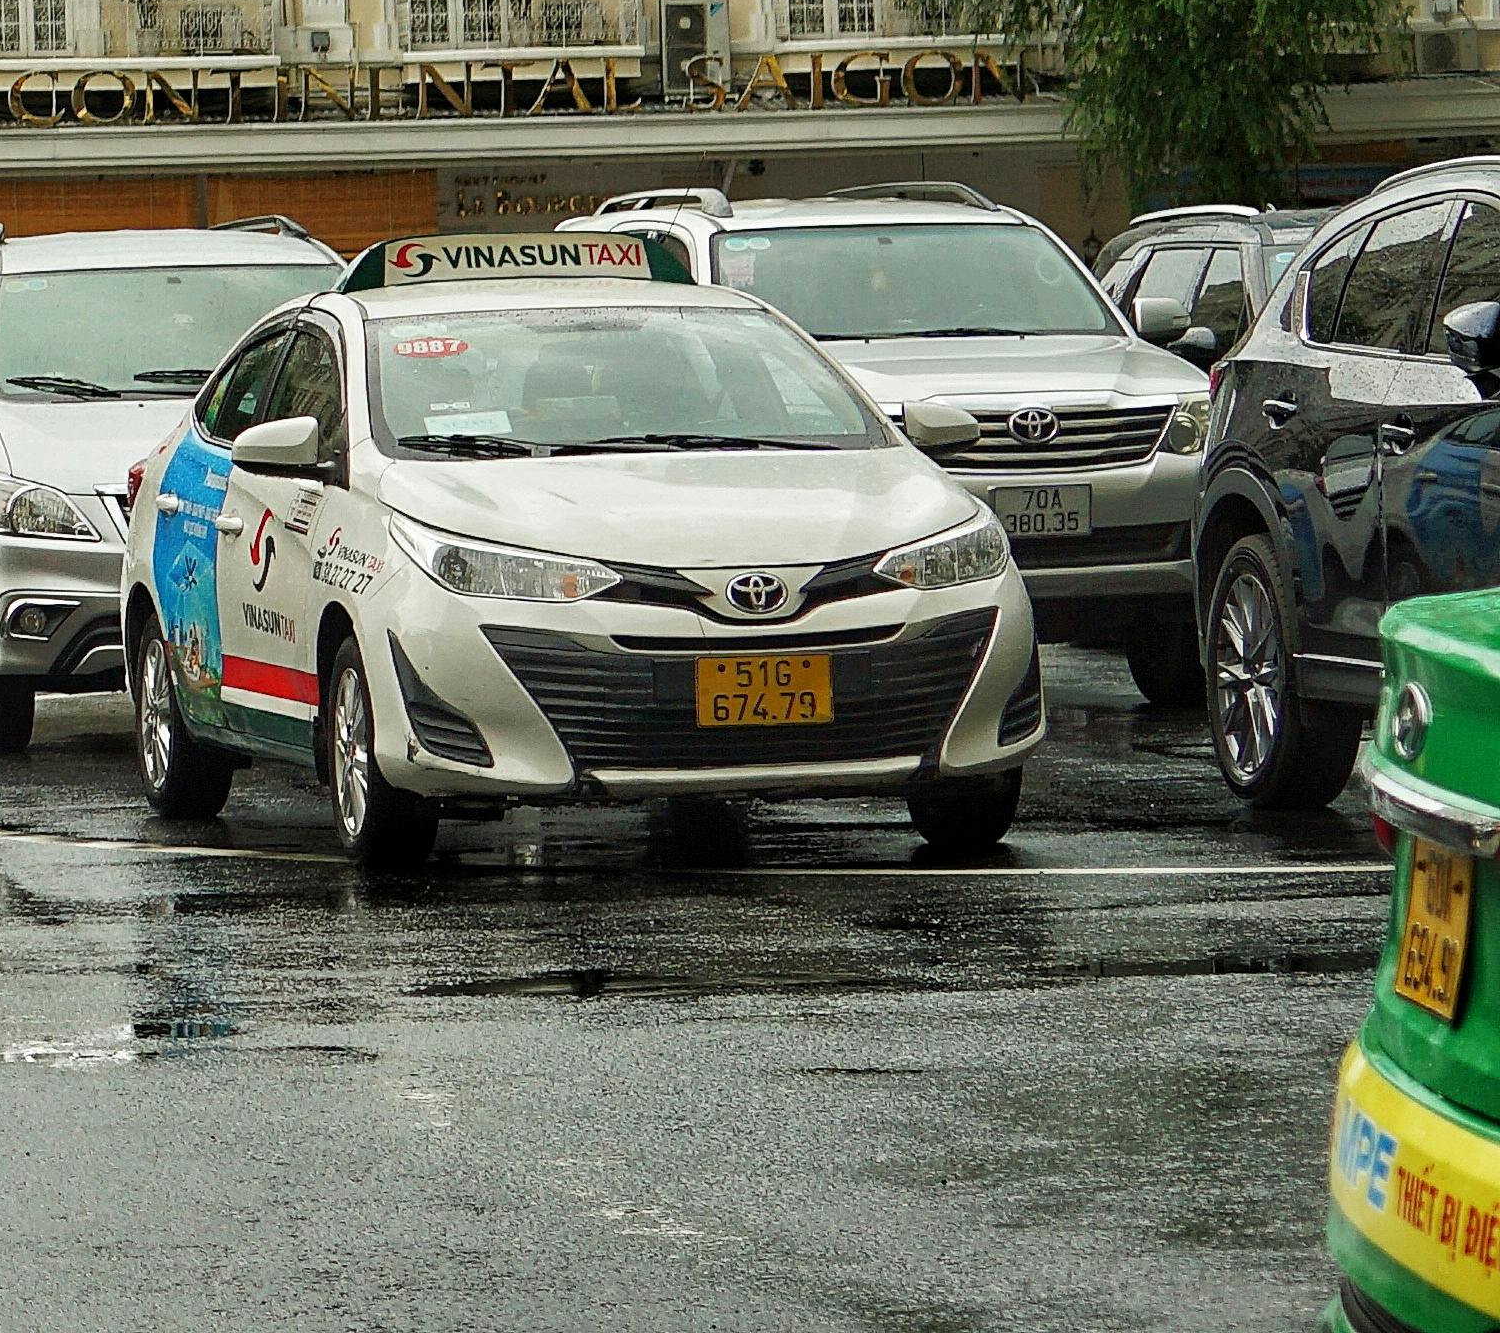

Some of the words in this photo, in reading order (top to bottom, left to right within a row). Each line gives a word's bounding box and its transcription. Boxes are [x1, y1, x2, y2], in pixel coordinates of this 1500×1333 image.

[7, 57, 642, 128] CONTINENTAL
[683, 48, 1027, 112] SAIGON
[396, 338, 461, 355] 9887
[1022, 488, 1063, 511] 70A
[1004, 511, 1080, 534] 380.35
[734, 659, 793, 689] 51G
[711, 690, 819, 724] 674.79
[1396, 1163, 1439, 1238] THIẾT
[1440, 1193, 1463, 1261] BỊ
